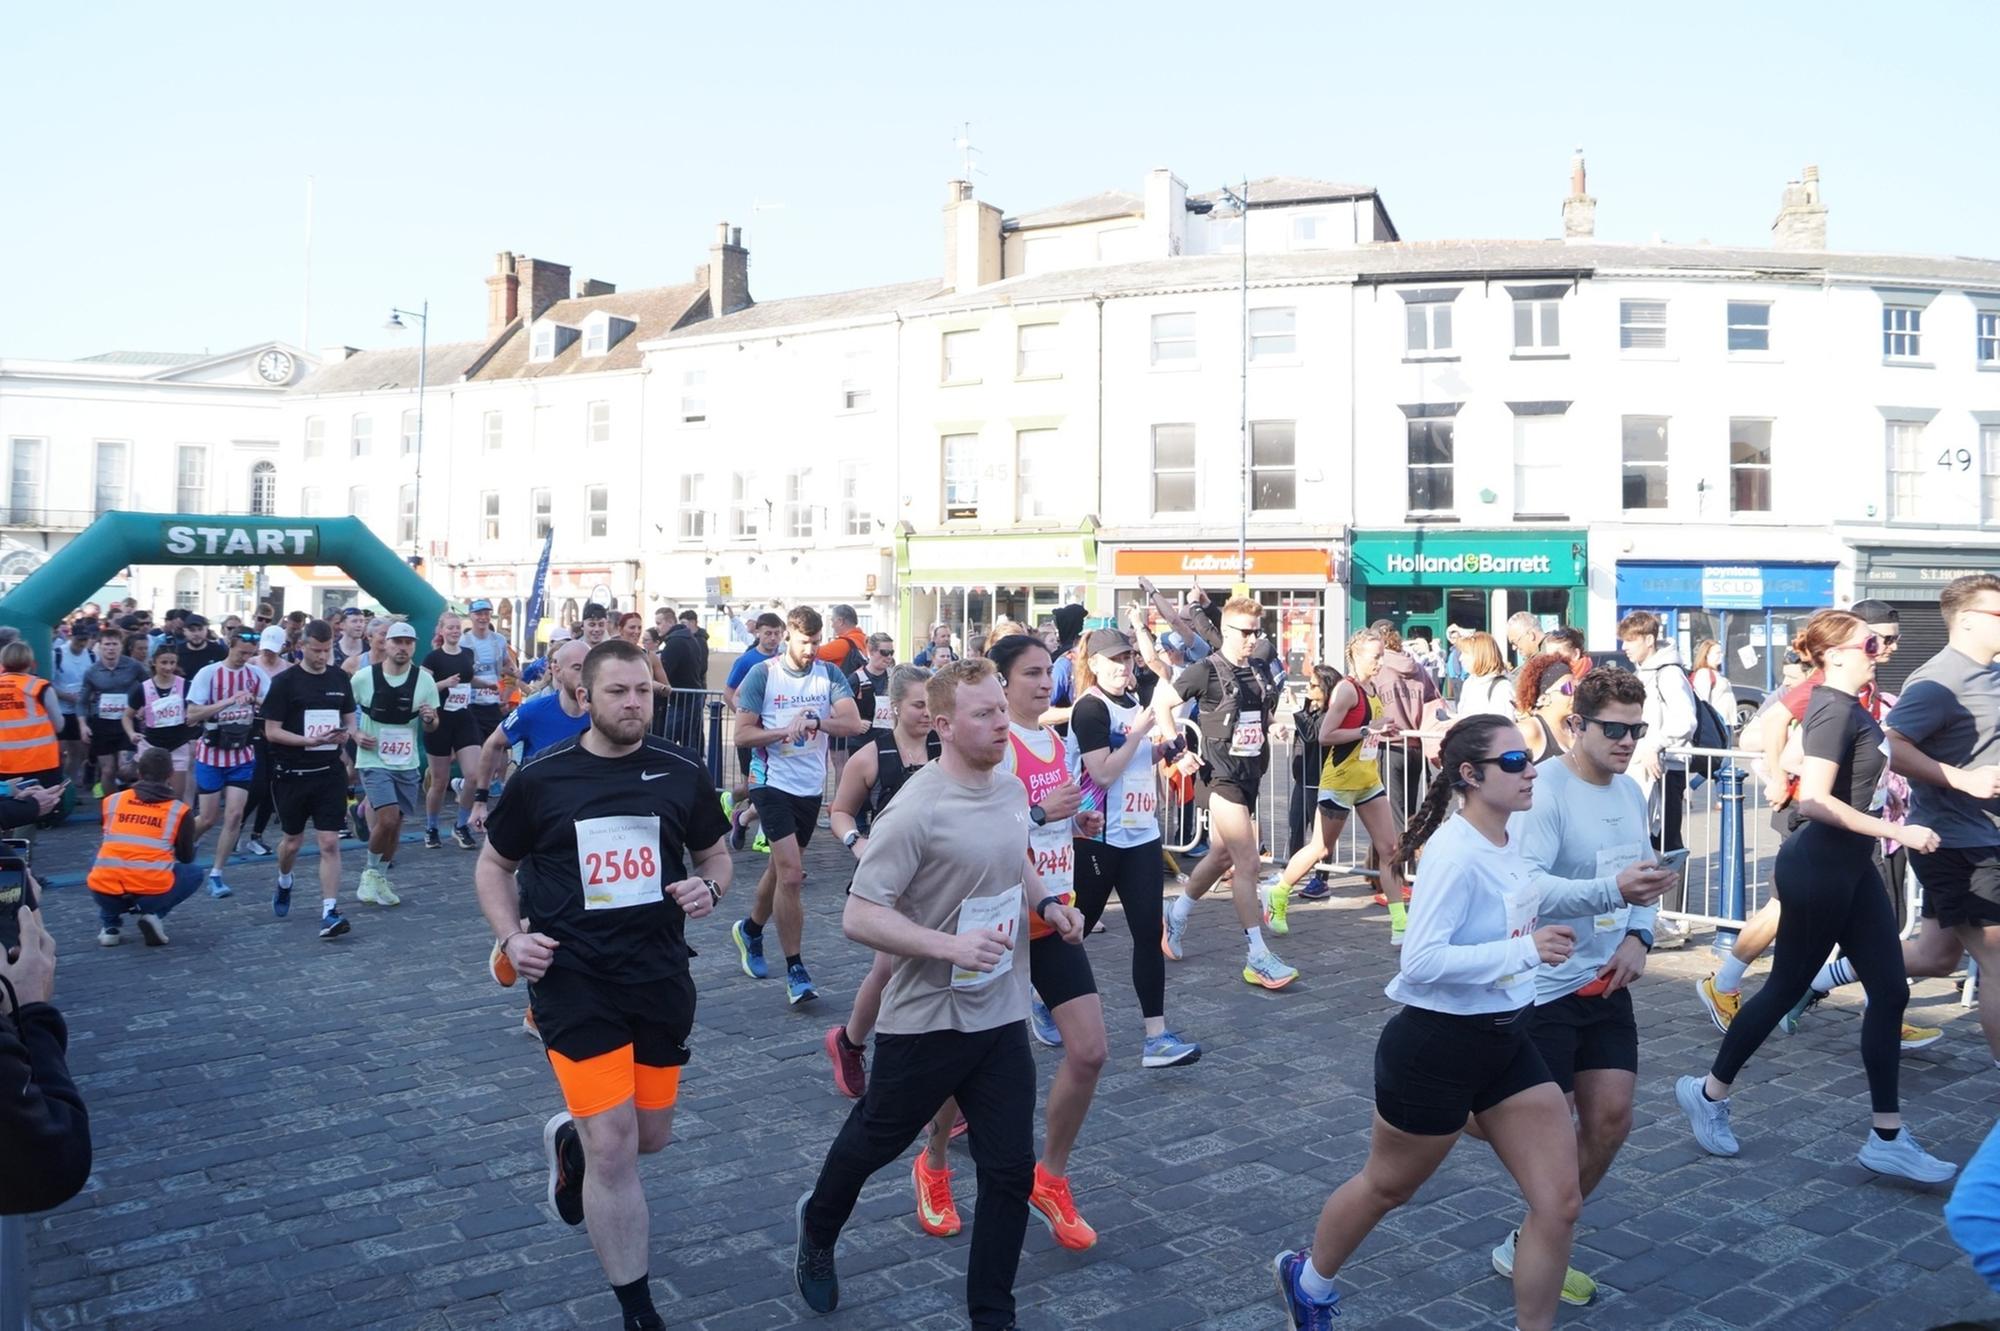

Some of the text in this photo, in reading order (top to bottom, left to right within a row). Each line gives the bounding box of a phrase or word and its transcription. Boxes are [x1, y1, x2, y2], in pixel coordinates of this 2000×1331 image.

[1936, 448, 1972, 472] 49
[166, 526, 314, 555] START
[381, 741, 411, 755] 2475
[1125, 792, 1155, 813] 210
[118, 812, 162, 828] OFFICIAL
[585, 846, 656, 885] 2568
